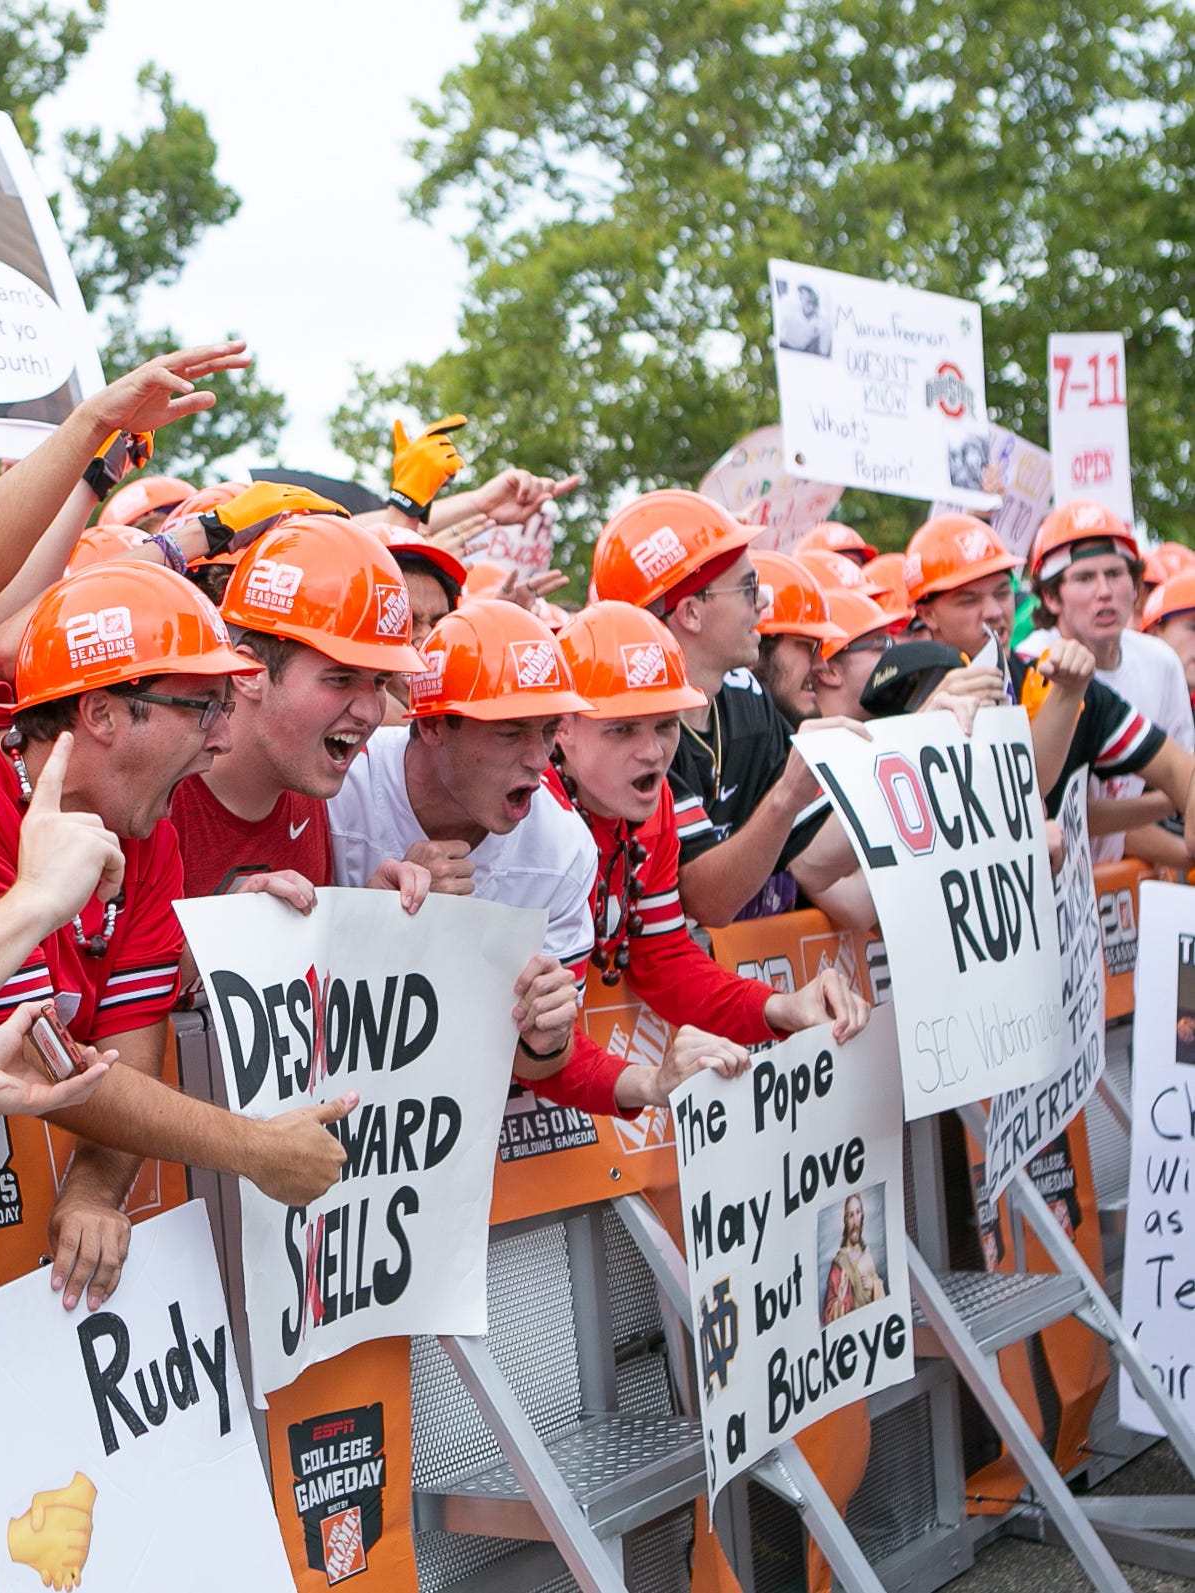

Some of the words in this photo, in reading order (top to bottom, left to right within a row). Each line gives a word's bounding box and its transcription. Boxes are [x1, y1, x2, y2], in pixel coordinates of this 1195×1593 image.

[12, 324, 38, 343] yo
[891, 312, 950, 349] Freeman
[846, 347, 918, 383] DOESN'T
[1053, 354, 1126, 410] 7-11
[864, 385, 908, 410] KNOW
[855, 451, 913, 483] Poppin'
[1071, 449, 1114, 485] OPEN
[630, 526, 682, 573] 20
[245, 588, 294, 609] SEASONS
[247, 559, 304, 597] 20
[66, 606, 133, 650] 20
[69, 637, 136, 662] SEASONS
[520, 641, 553, 685] HOME
[628, 643, 662, 686] HOME
[816, 744, 995, 869] LOCK
[990, 742, 1034, 841] UP
[940, 854, 1040, 973] RUDY
[1099, 888, 1137, 949] 20
[915, 1016, 969, 1093] SEC
[498, 1105, 594, 1146] SEASONS
[678, 1093, 726, 1168] The
[753, 1049, 834, 1134] Pope
[988, 1031, 1100, 1196] GIRLFRIEND
[321, 1096, 462, 1184] WARD
[501, 1147, 512, 1160] OF
[513, 1137, 552, 1158] BUILDING
[554, 1129, 598, 1151] GAMEDAY
[1030, 1152, 1067, 1178] COLLEGE
[692, 1190, 772, 1272] May
[783, 1136, 866, 1215] Love
[1144, 1209, 1184, 1237] as
[755, 1253, 803, 1337] but
[77, 1301, 232, 1457] Rudy
[727, 1410, 746, 1465] a
[767, 1313, 906, 1435] Buckeye
[313, 1418, 355, 1441] ESPN
[300, 1436, 372, 1476] COLLEGE
[295, 1459, 384, 1513] GAMEDAY
[327, 1521, 342, 1548] THE
[327, 1509, 361, 1580] HOME
[342, 1529, 363, 1574] DEPOT
